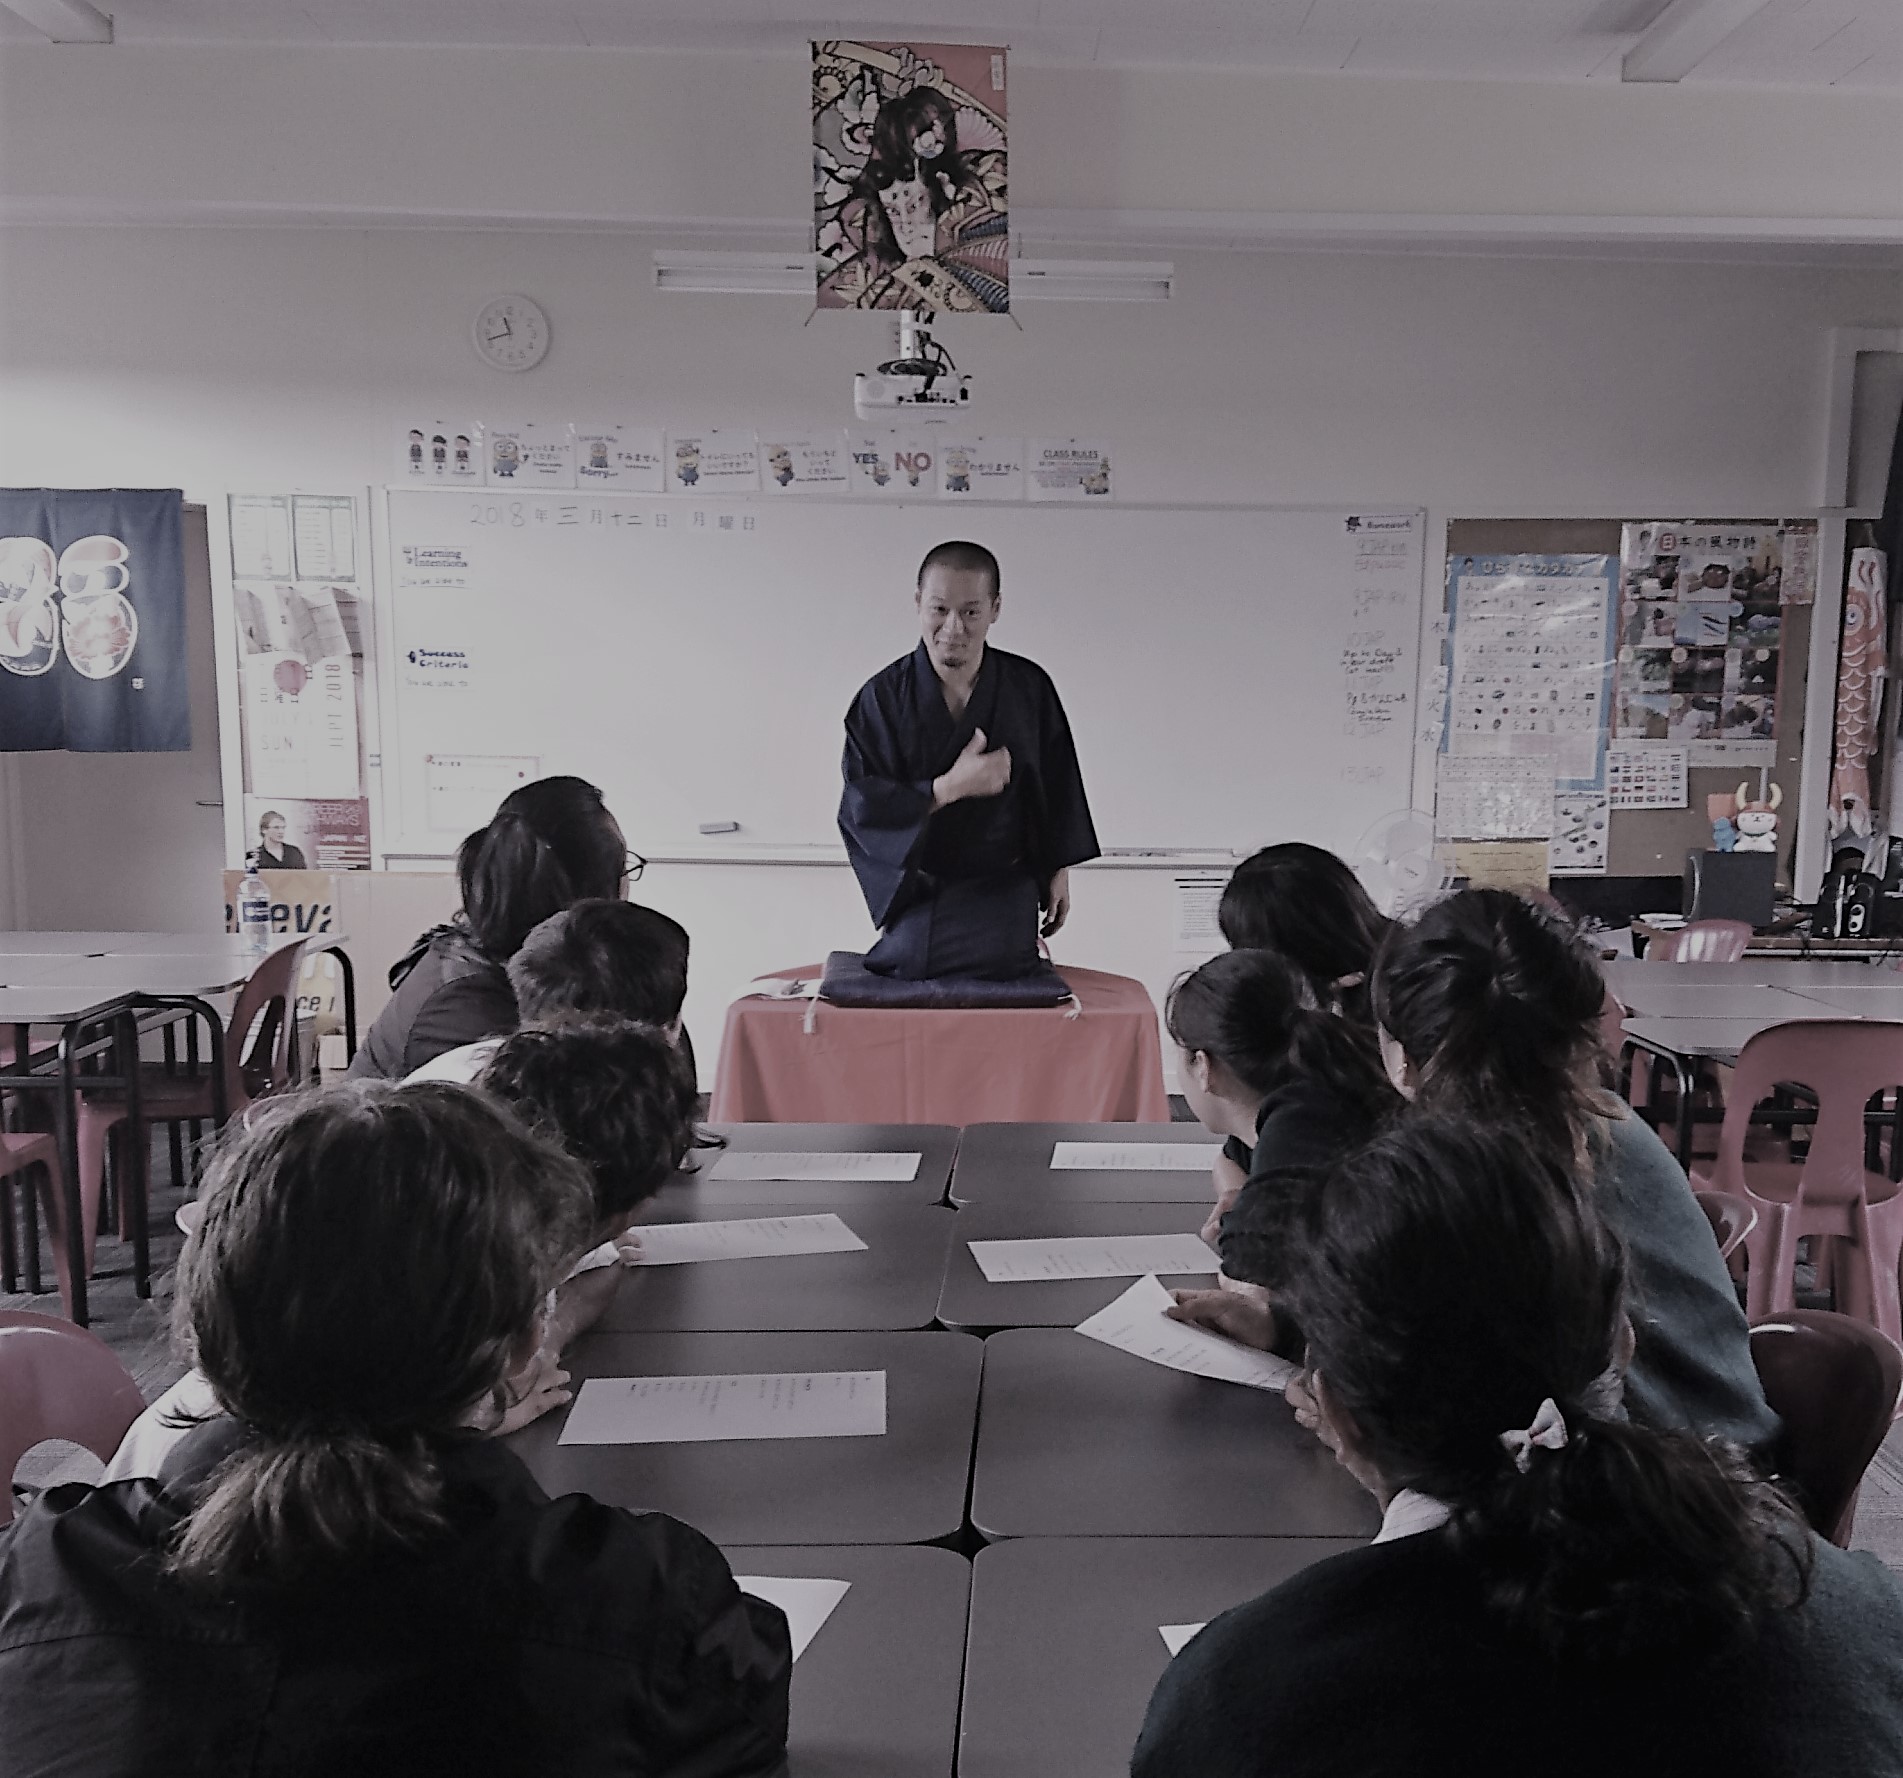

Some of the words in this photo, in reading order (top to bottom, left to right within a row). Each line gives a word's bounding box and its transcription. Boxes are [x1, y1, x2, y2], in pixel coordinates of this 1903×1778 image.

[1043, 449, 1070, 459] CLASS
[1071, 449, 1099, 459] RULES
[852, 452, 879, 464] YES
[895, 452, 932, 472] NO
[414, 547, 462, 559] Learning
[418, 648, 466, 657] Success
[419, 659, 469, 669] Criteria
[324, 664, 342, 701] 2018
